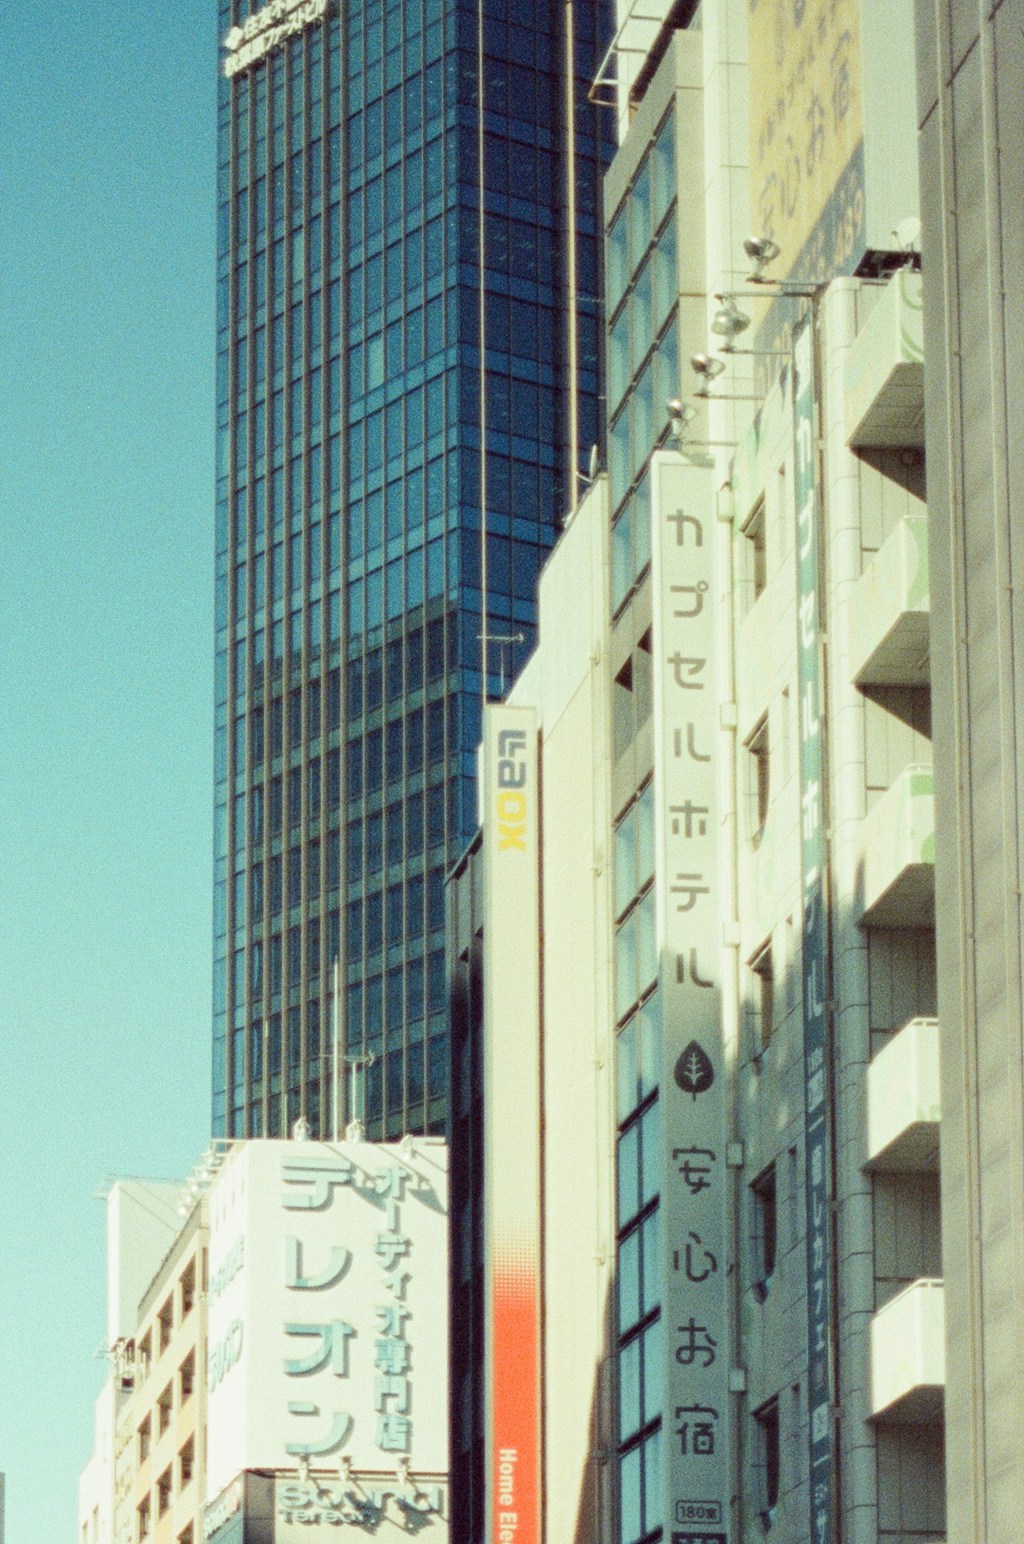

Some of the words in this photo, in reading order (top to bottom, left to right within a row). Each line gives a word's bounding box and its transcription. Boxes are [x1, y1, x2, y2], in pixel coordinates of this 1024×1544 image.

[666, 508, 714, 990] カプセルホテル
[282, 1158, 355, 1455] テレオン
[374, 1166, 411, 1452] オーディオ専門店
[672, 1146, 719, 1456] 安心お宿
[499, 1449, 517, 1507] Home
